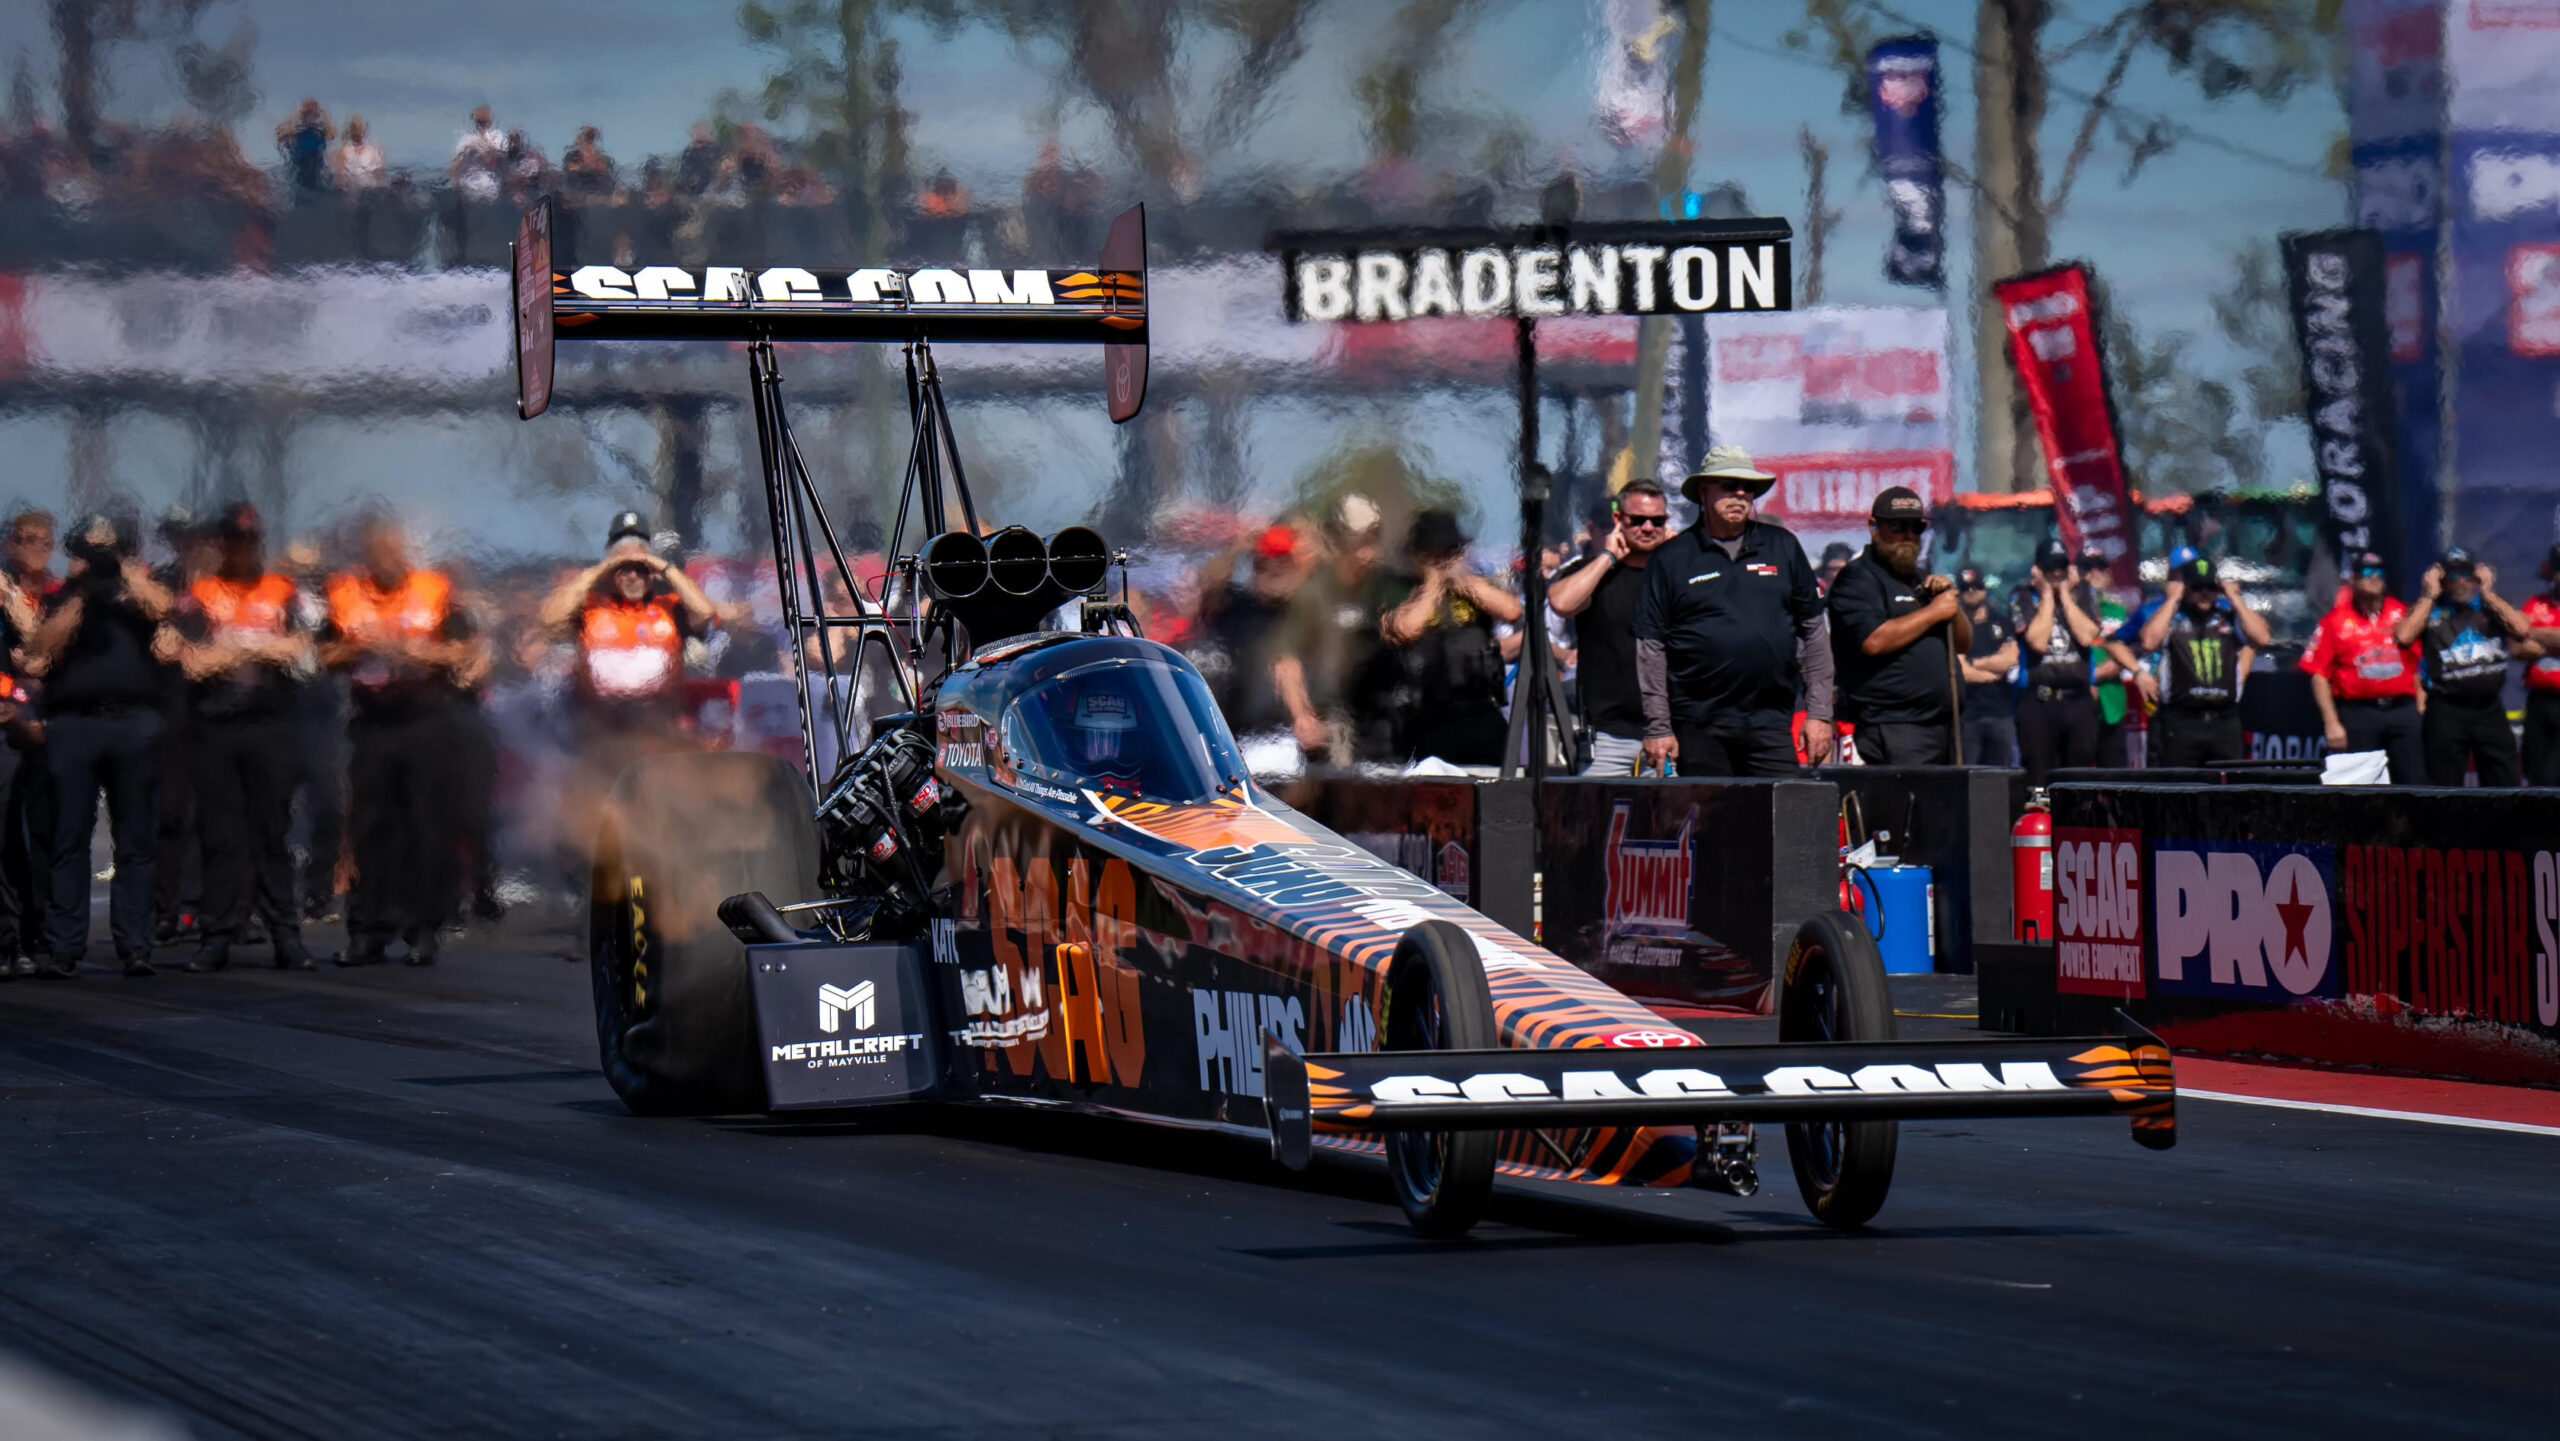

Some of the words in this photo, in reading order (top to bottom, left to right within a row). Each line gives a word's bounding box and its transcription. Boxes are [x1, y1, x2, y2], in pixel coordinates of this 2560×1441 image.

[571, 265, 1056, 308] SCAGCOM
[1301, 245, 1776, 321] BRADENTON
[946, 714, 979, 727] BLUEBIRD
[946, 743, 981, 767] TOYOTA
[911, 785, 932, 809] MSD
[1604, 802, 1694, 948] SUMMIT
[2057, 840, 2139, 939] SCAG
[2155, 850, 2332, 995] PRO
[2345, 845, 2531, 1023] SUPERSTAR
[2534, 849, 2560, 1027] S
[2059, 942, 2091, 980] POWER
[2092, 943, 2141, 983] EQUIPMENT
[772, 1033, 924, 1062] METALCRAFT
[807, 1058, 826, 1069] OF
[828, 1055, 887, 1068] MAYVILLE
[1369, 1062, 2069, 1101] SCAGCOM
